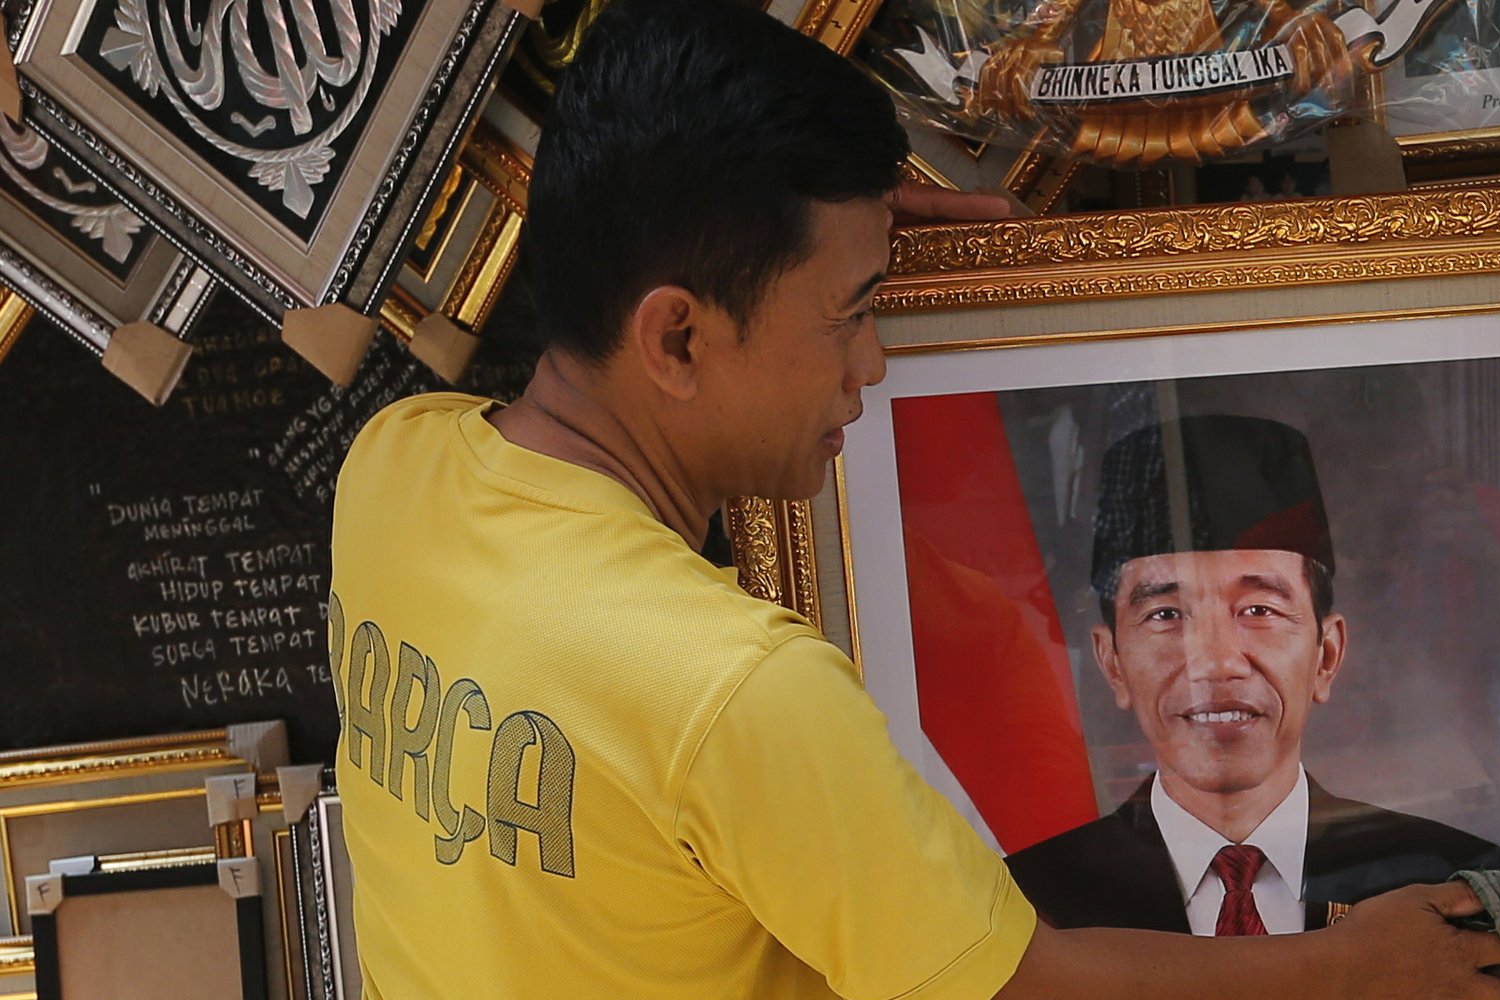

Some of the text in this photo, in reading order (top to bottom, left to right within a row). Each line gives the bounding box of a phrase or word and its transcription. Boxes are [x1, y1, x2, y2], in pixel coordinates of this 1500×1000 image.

[1037, 46, 1288, 97] BHINNEKA TUNGGAL IKA
[225, 543, 317, 574] TEMPAT
[160, 574, 321, 602] HIDUP TEMPAT
[133, 612, 201, 638] KUBUR
[209, 605, 301, 630] TEMPAT
[229, 629, 316, 655] TEMPAT
